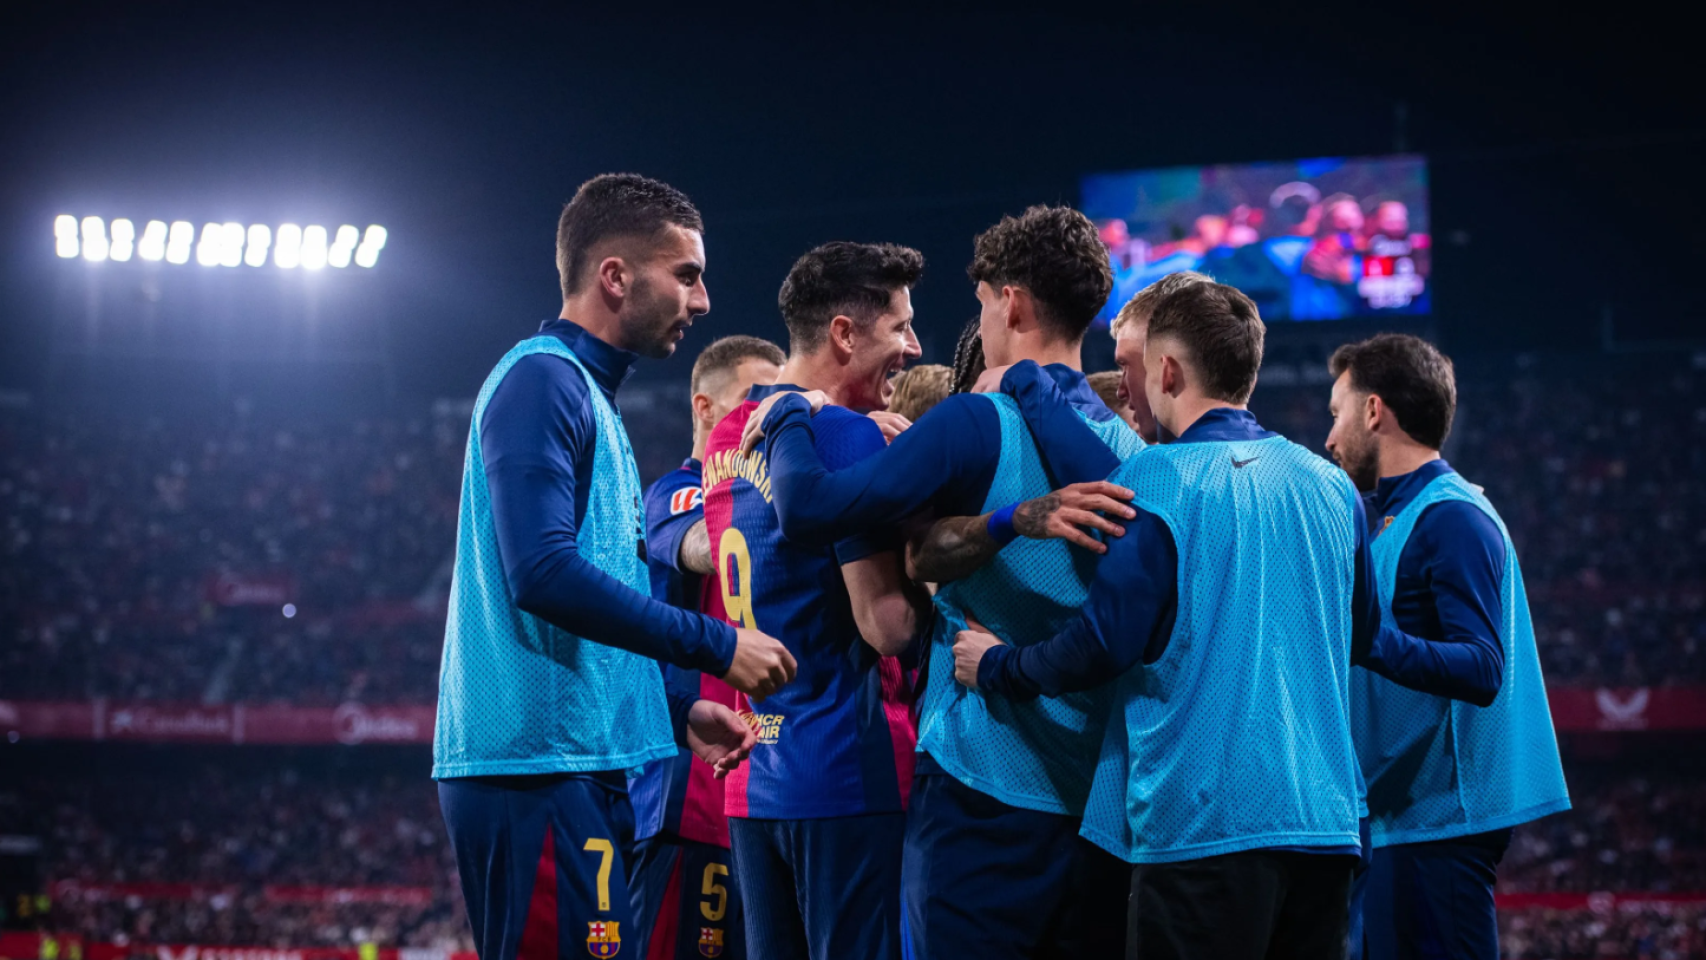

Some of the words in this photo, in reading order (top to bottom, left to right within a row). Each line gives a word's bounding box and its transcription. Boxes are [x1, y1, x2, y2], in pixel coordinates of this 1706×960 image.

[702, 448, 773, 504] EWANDOWSK
[719, 527, 758, 630] 9
[583, 838, 614, 911] 7
[700, 862, 729, 921] 5
